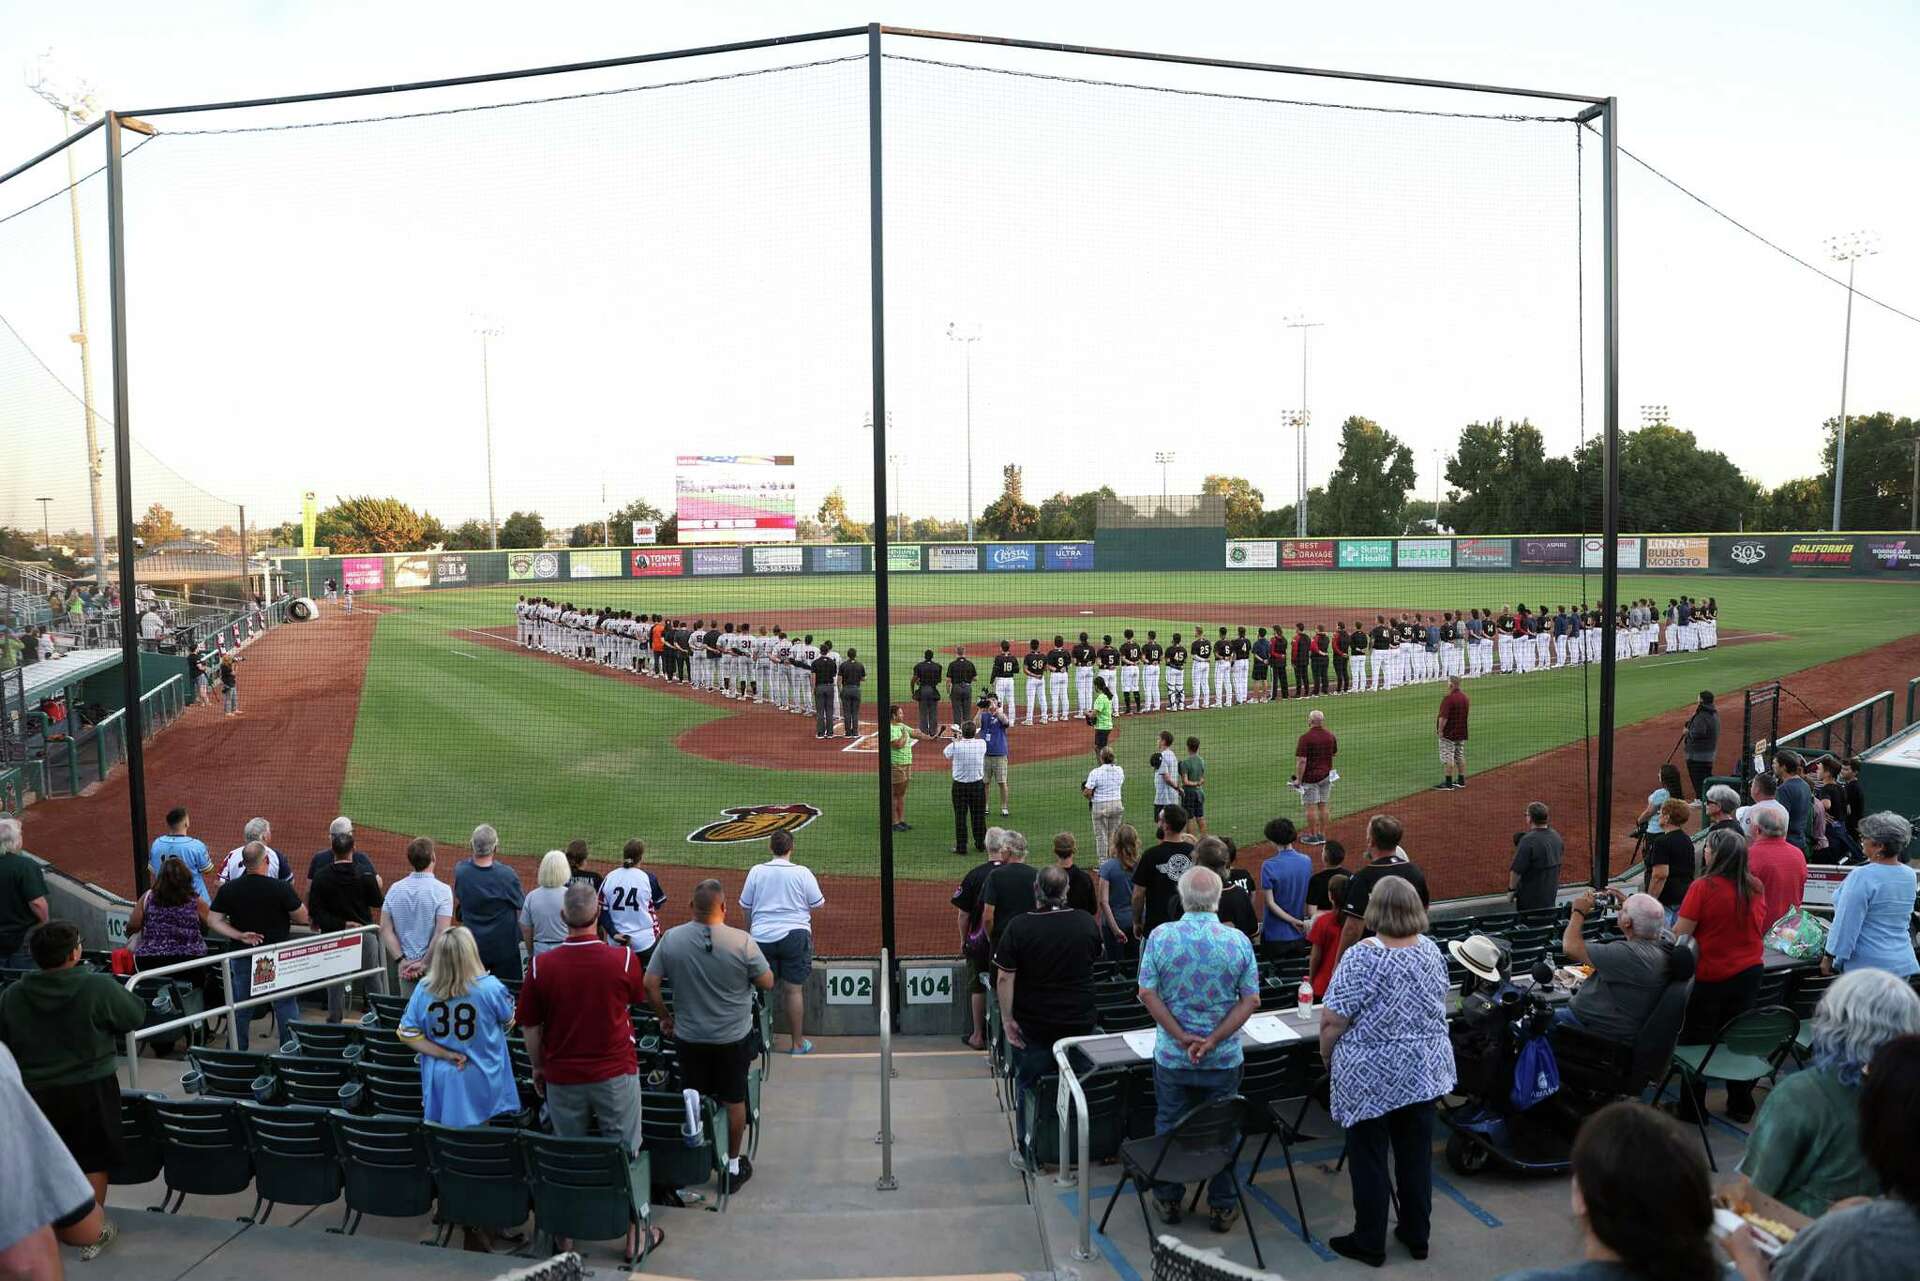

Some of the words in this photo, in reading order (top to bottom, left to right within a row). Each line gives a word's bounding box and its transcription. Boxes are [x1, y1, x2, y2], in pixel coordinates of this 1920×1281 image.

[1647, 548, 1685, 558] BUILDS
[1731, 545, 1766, 560] 805
[1791, 544, 1854, 553] CALIFORNIA
[1360, 554, 1389, 562] Health
[1647, 558, 1700, 566] MODESTO
[741, 640, 751, 649] 31
[804, 650, 815, 660] 18
[1083, 649, 1090, 659] 7
[1130, 648, 1138, 658] 10
[1200, 645, 1210, 655] 25
[1108, 655, 1115, 664] 5
[612, 886, 640, 912] 24
[829, 976, 871, 997] 102
[909, 975, 951, 997] 104
[427, 1001, 477, 1041] 38
